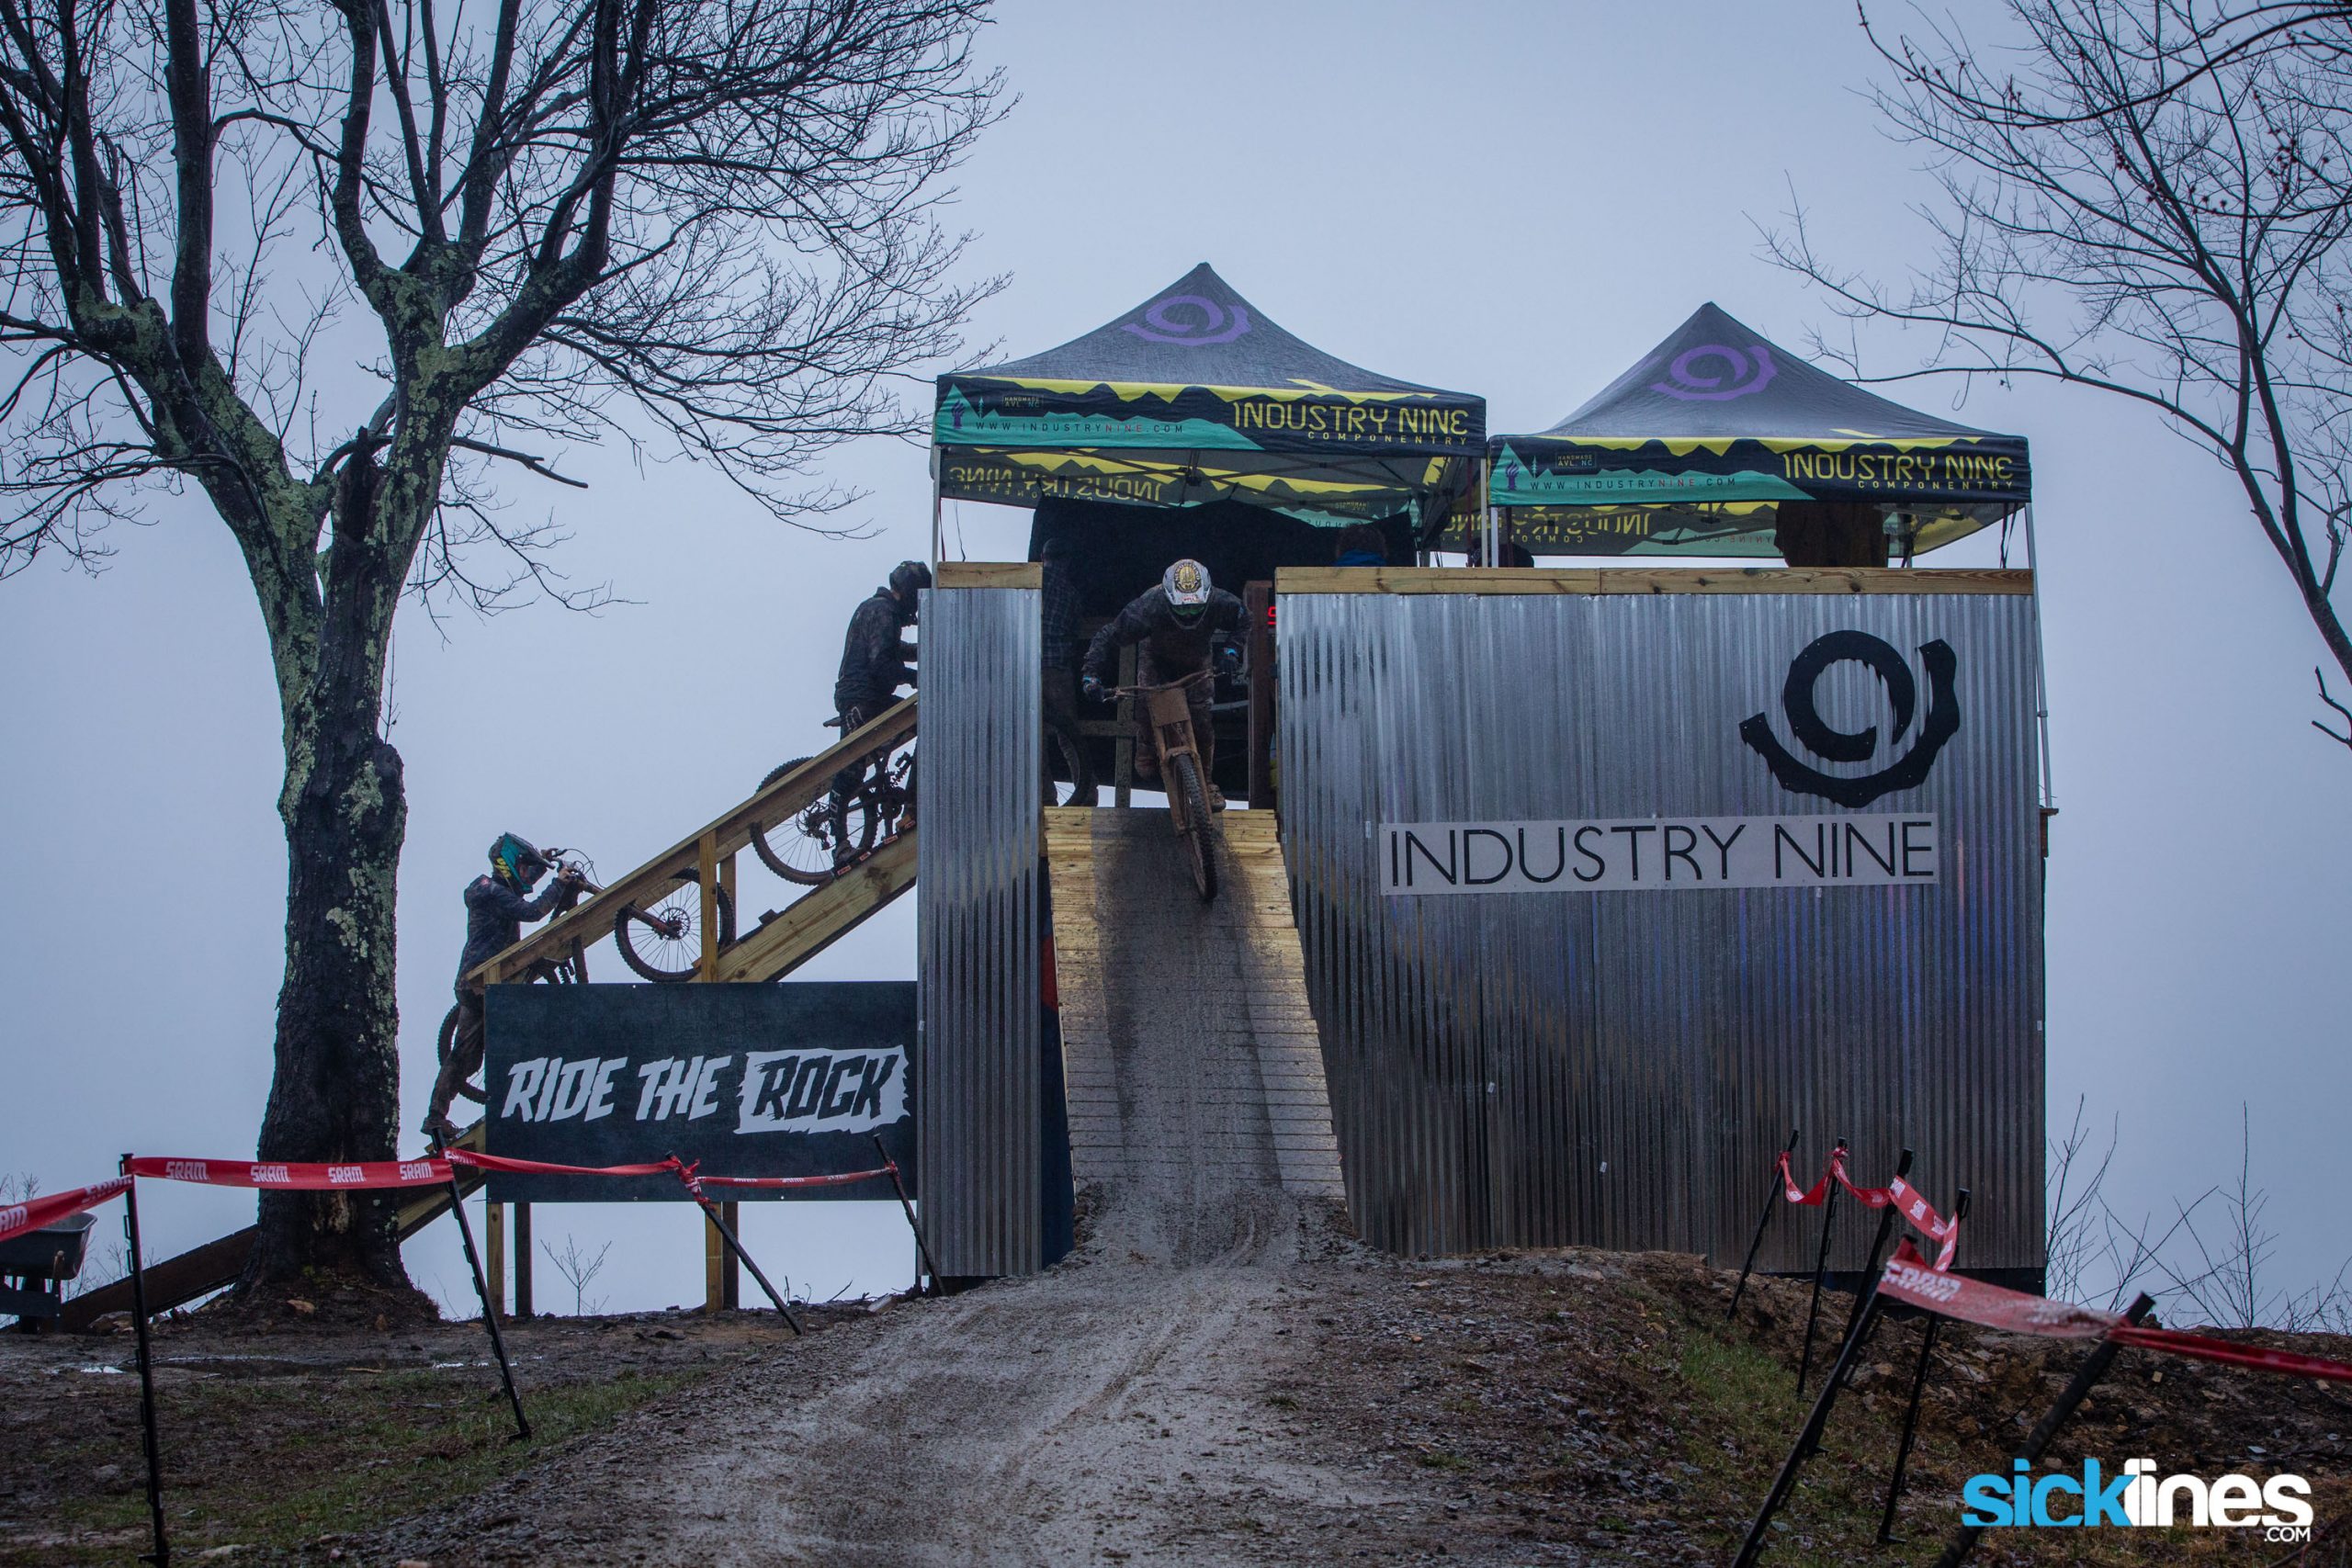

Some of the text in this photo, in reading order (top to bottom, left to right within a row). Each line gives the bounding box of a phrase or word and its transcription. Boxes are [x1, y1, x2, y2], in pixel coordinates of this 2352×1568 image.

[1233, 401, 1469, 435] INDUSTRY NINE
[1307, 430, 1467, 446] COMPONENTRY
[1782, 453, 2014, 480] INDUSTRY NINE
[1858, 480, 2014, 490] COMPONENTRY
[1391, 820, 1934, 887] INDUSTRY NINE
[501, 1053, 901, 1122] RIDE THE ROCK
[165, 1161, 433, 1183] SRAM SRAM SRAM SRAM
